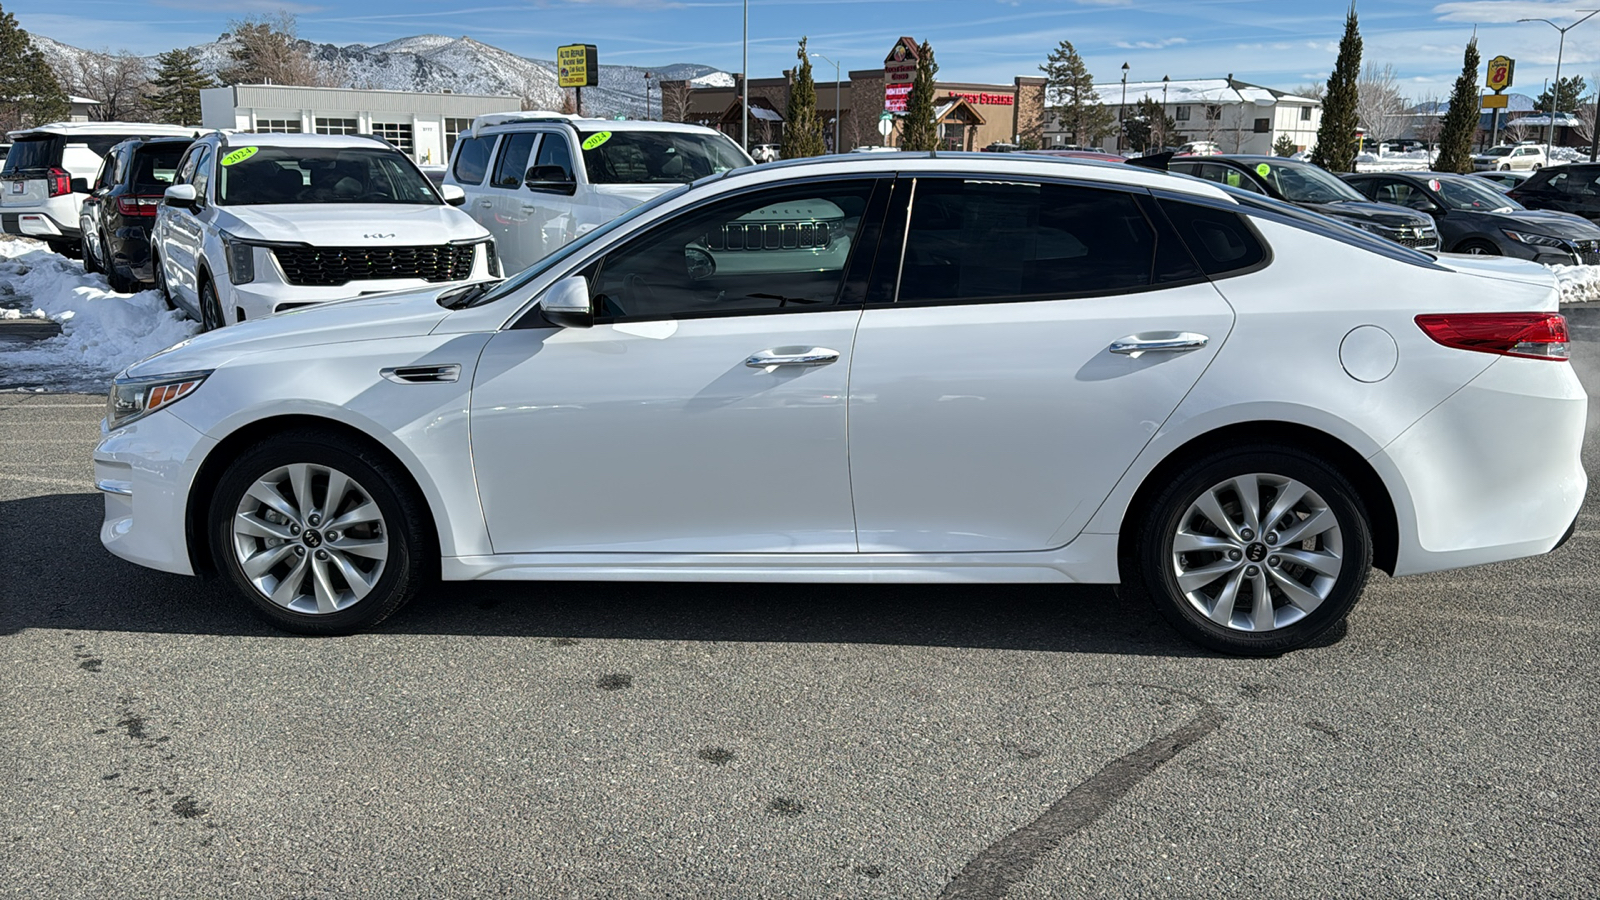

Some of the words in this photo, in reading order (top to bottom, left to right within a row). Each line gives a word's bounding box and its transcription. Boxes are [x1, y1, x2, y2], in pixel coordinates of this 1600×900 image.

[1492, 66, 1507, 83] 8
[980, 92, 1014, 105] STRIKE
[586, 132, 607, 148] 2024
[226, 147, 252, 164] 2024
[305, 531, 320, 547] KIA
[1251, 544, 1263, 560] KIA
